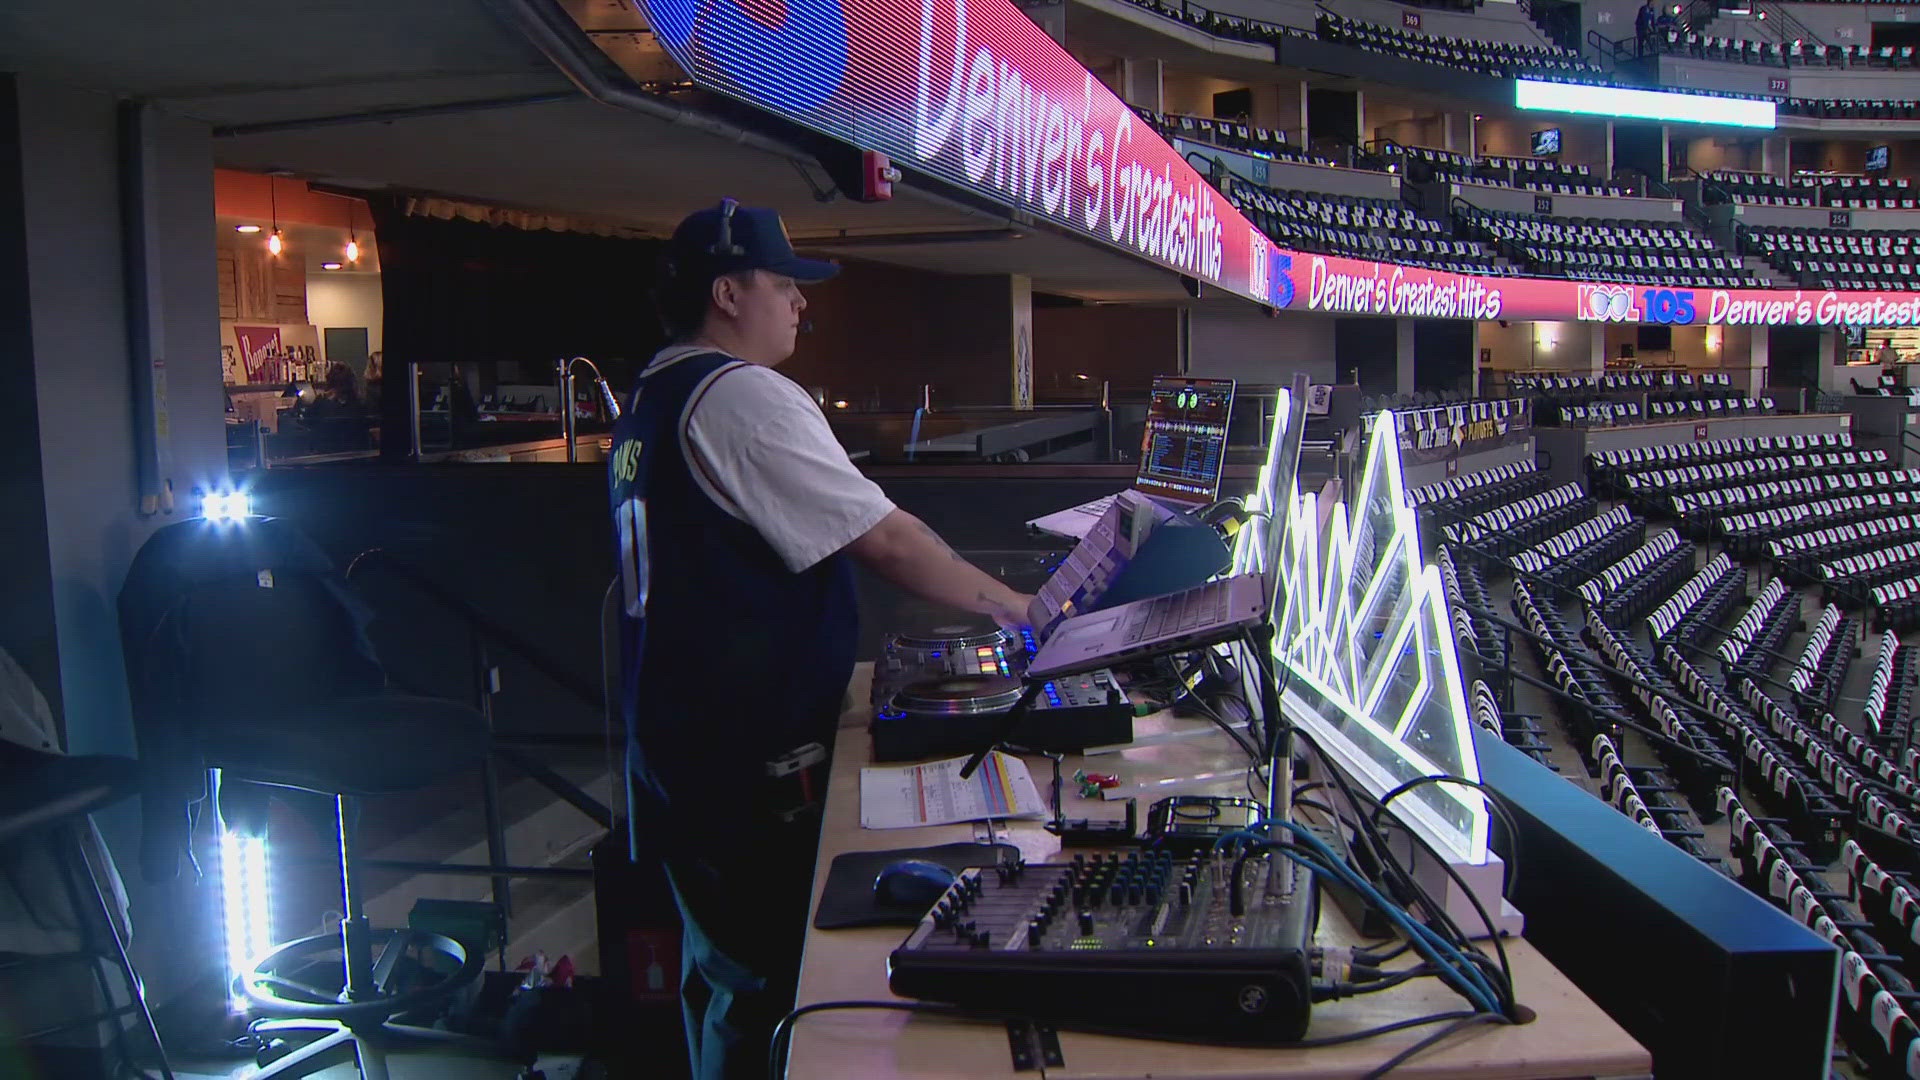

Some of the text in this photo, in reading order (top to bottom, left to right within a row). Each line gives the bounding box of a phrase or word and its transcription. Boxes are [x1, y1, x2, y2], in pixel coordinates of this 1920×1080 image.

[1405, 15, 1418, 26] 369
[1771, 80, 1786, 90] 373
[914, 0, 1104, 231] Denver's
[1109, 108, 1196, 271] Greatest
[1196, 181, 1222, 281] Hits
[1537, 199, 1549, 210] 252
[1832, 215, 1847, 225] 254
[1308, 256, 1502, 320] Denver's Greatest Hits
[1577, 284, 1920, 327] KOOL 105 Denver's Greatest
[1696, 427, 1706, 437] 142
